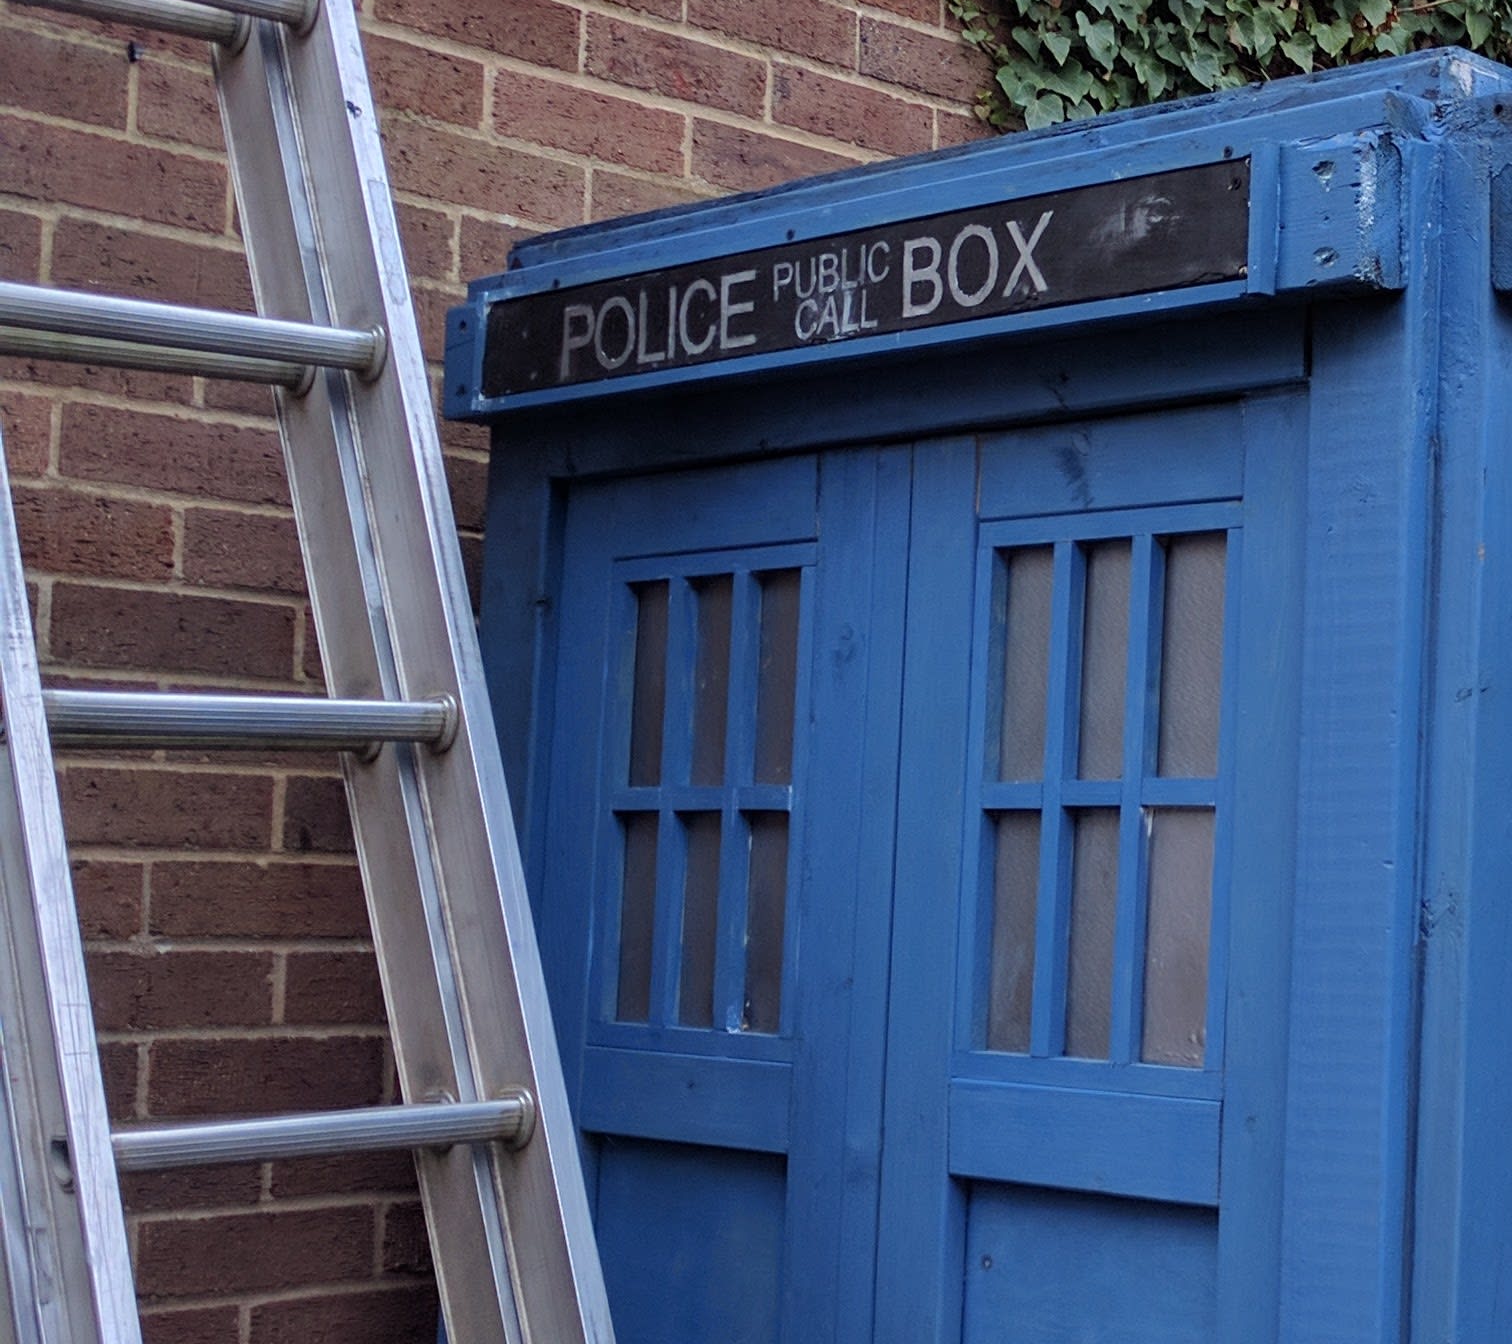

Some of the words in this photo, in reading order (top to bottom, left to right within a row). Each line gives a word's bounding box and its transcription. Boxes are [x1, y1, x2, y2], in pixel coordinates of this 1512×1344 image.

[773, 241, 890, 302] PUBLIC
[902, 210, 1054, 318] BOX
[560, 269, 757, 381] POLICE
[794, 289, 878, 340] CALL
